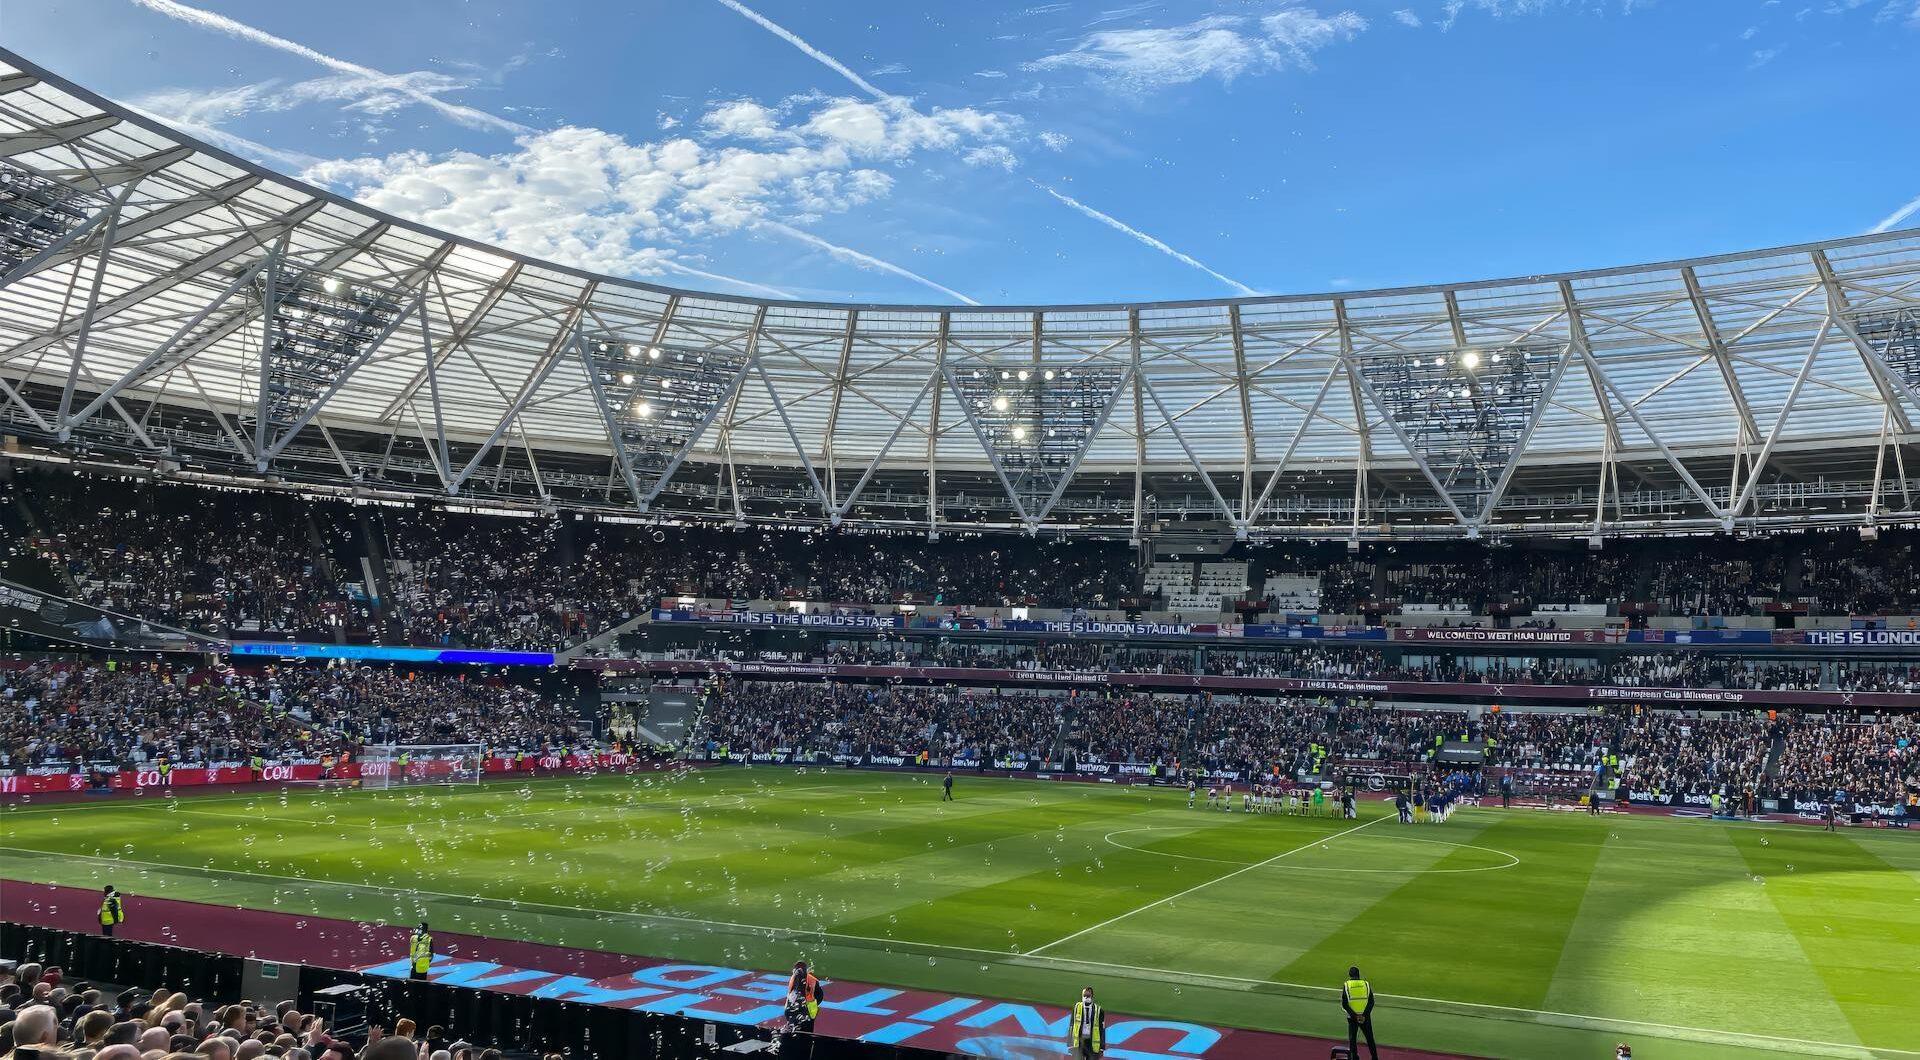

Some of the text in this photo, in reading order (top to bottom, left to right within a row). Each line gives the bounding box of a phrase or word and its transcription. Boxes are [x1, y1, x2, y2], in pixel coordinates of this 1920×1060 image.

[733, 611, 895, 627] THIS IS THE WORLD'S STAGE
[1044, 621, 1192, 636] THIS IS LONDON STADIUM
[1427, 631, 1571, 642] WELCOME TO WEST HAM UNITED
[1807, 631, 1845, 644] THIS
[1849, 631, 1864, 644] IS
[1620, 690, 1662, 698] European
[1663, 690, 1682, 699] Cup
[1724, 692, 1744, 702] Cup
[871, 755, 905, 766] betway
[1076, 762, 1110, 773] betway
